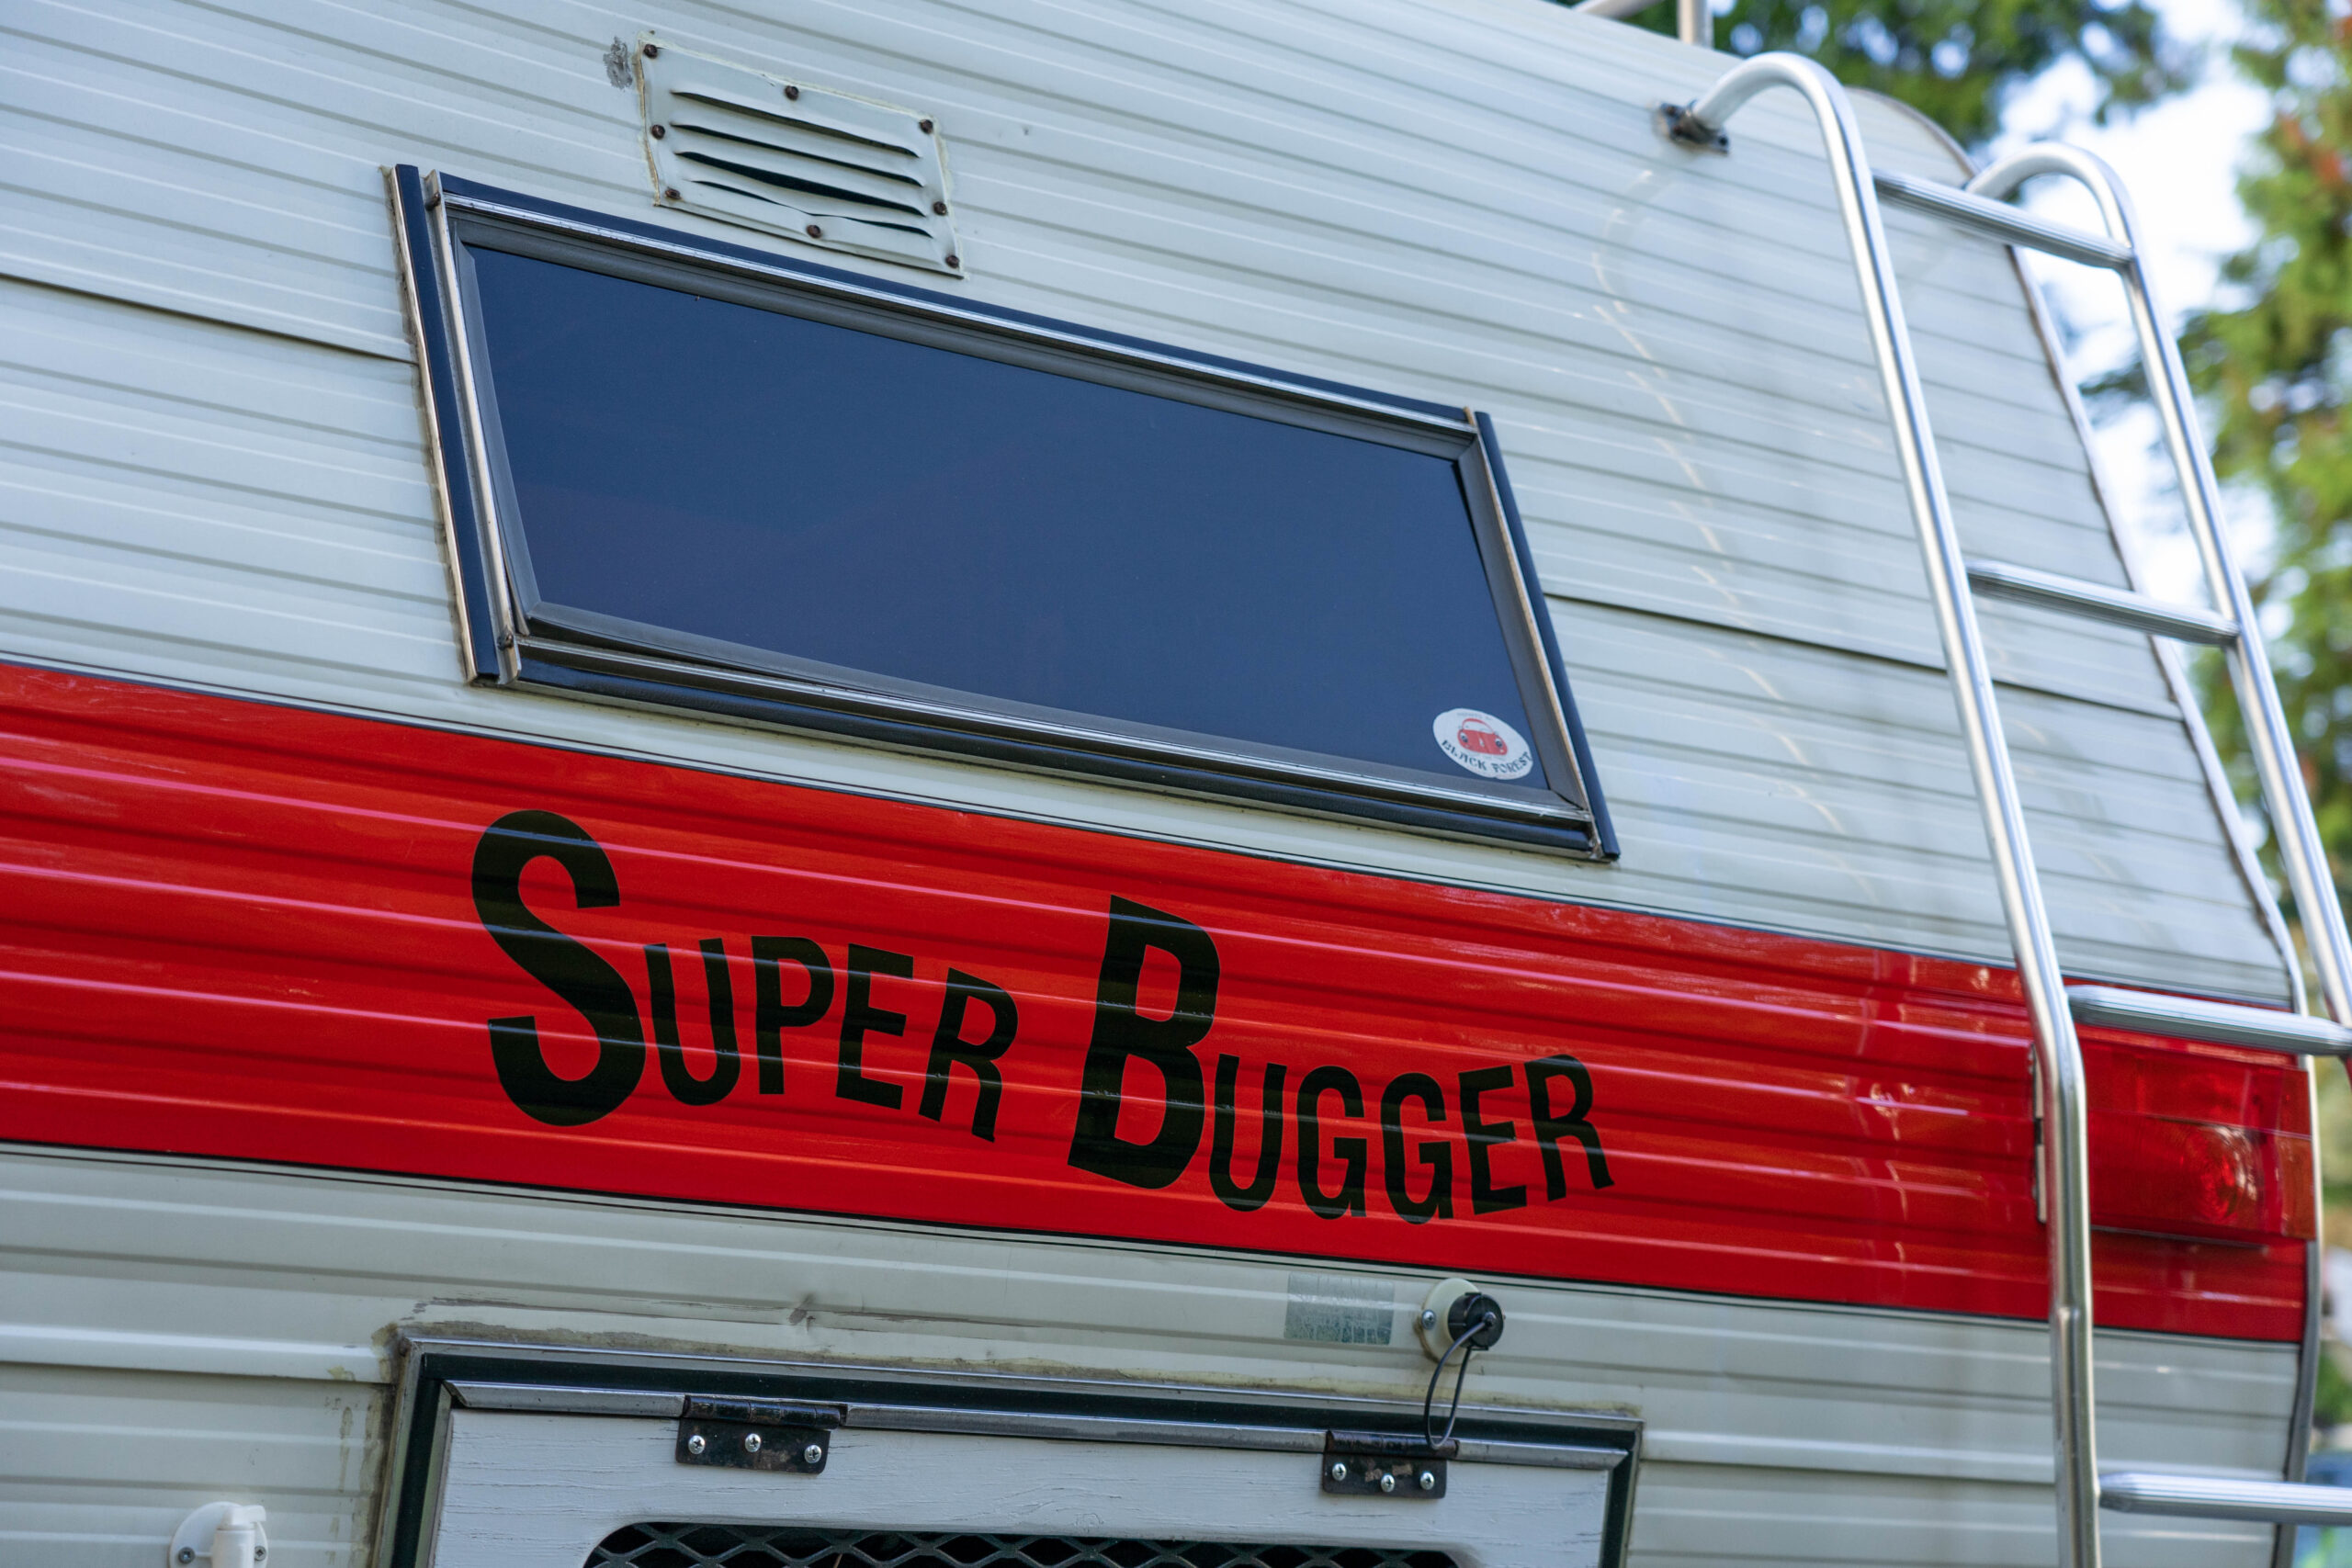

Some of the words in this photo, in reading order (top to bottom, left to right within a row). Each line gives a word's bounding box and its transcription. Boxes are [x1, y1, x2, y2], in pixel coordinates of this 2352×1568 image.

[1442, 739, 1487, 771] BLACK
[1490, 751, 1532, 773] FOREST
[472, 810, 1018, 1144] SUPER
[1068, 894, 1614, 1224] BUGGER
